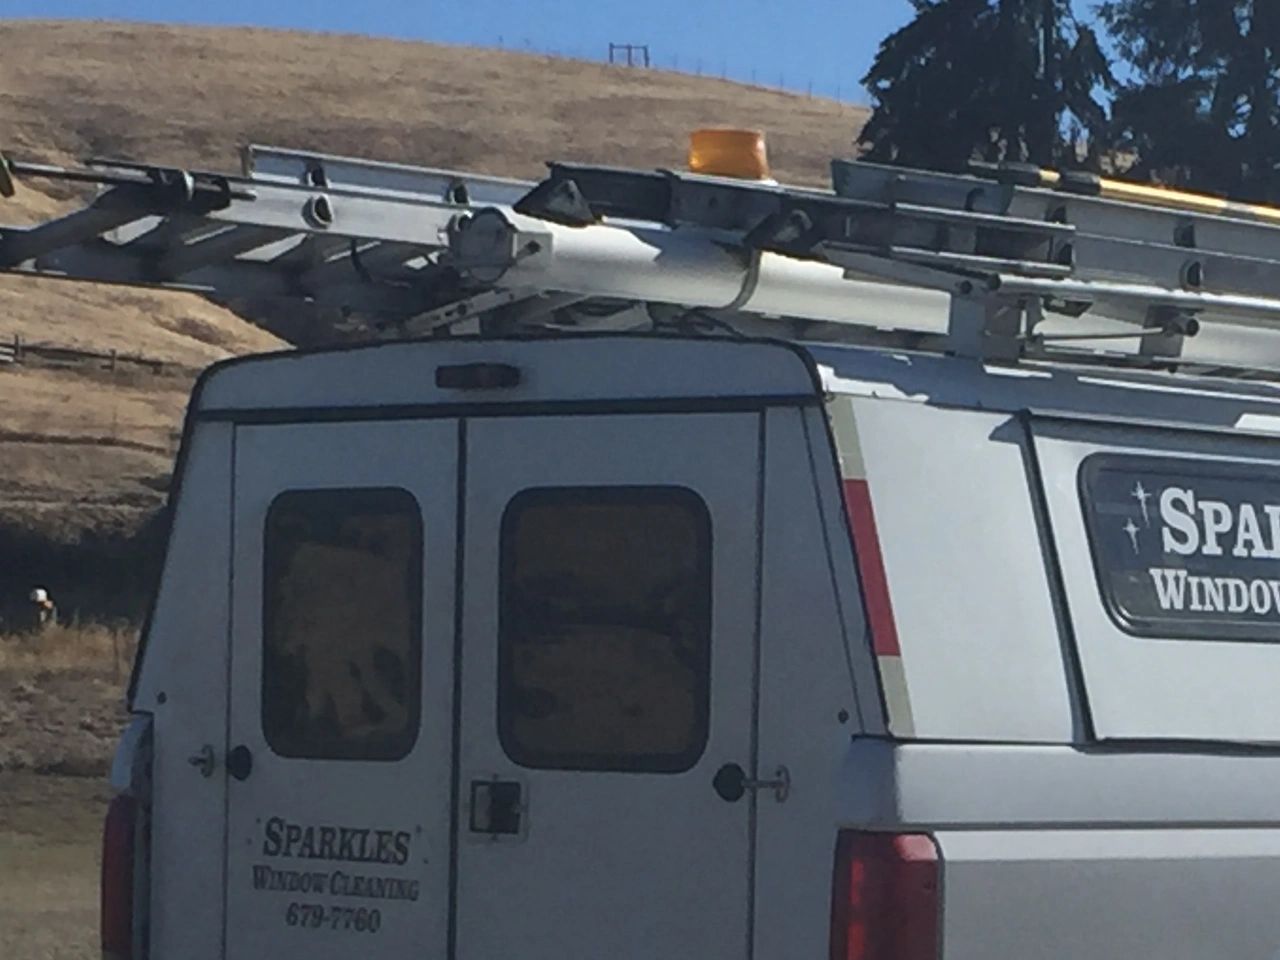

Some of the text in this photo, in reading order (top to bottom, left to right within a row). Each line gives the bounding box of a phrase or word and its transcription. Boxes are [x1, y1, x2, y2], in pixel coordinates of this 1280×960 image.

[263, 816, 411, 865] SPARKLES
[253, 865, 419, 901] WINDOW CLEANING
[286, 902, 381, 933] 679-7760
